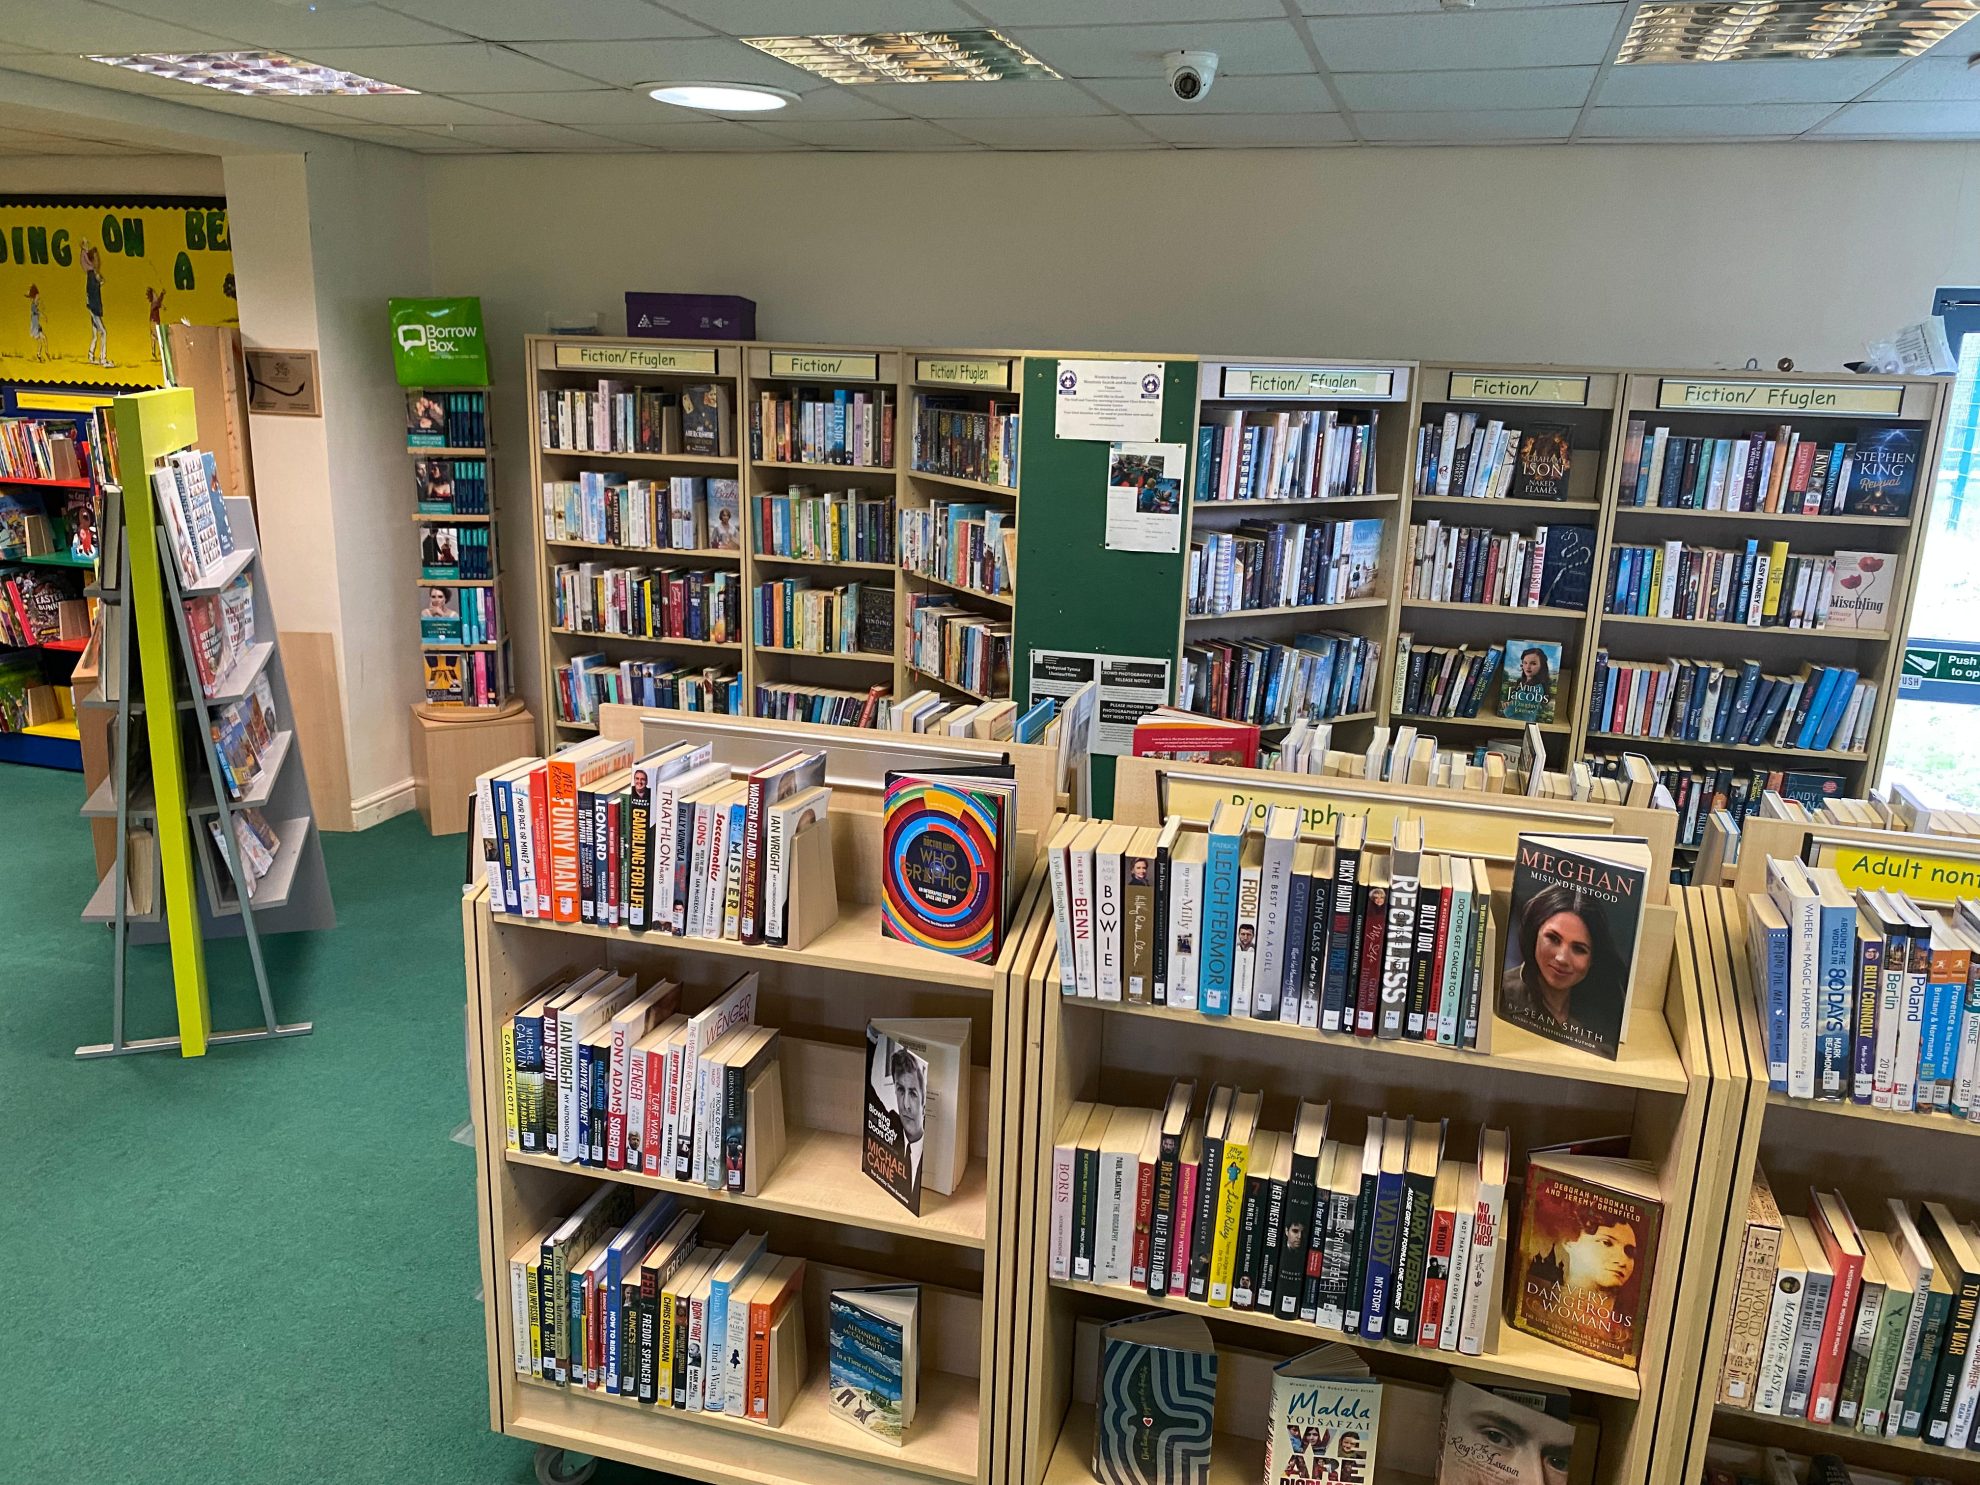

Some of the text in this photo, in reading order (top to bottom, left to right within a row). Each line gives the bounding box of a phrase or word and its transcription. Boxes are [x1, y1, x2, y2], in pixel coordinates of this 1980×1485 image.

[102, 214, 144, 257] ON
[186, 211, 231, 250] BE
[174, 252, 195, 290] A
[426, 325, 476, 338] Borrow
[428, 339, 458, 352] Box.
[581, 349, 675, 367] Fiction/ Ffuglen
[792, 358, 842, 373] Fiction/
[930, 364, 988, 386] Fiction/ Ffuglen
[1250, 374, 1357, 392] Fiction/ Ffuglen
[1473, 379, 1539, 395] Fiction/
[1685, 386, 1836, 408] Fiction/ Ffuglen
[1523, 463, 1564, 477] ISON
[1527, 455, 1563, 463] GRAHAM
[1854, 451, 1915, 463] STEPHEN
[1860, 462, 1904, 476] KING
[1525, 486, 1557, 494] FLAMES
[1754, 558, 1767, 604] EASY MONEY
[38, 602, 58, 611] BUNN
[1830, 596, 1883, 614] Mischling
[1948, 656, 1977, 665] Push
[1952, 668, 1980, 679] to op
[1508, 687, 1548, 703] Jacobs
[1517, 682, 1541, 692] Anna
[1902, 677, 1919, 686] USH
[1789, 791, 1817, 800] ANDY
[521, 831, 526, 839] OR
[596, 799, 606, 860] LEONARD
[632, 809, 646, 866] GAMBLING
[660, 790, 672, 866] TRIATHLON
[747, 783, 759, 860] WARREN GATLAND
[552, 798, 577, 891] FUNNY MAN
[710, 813, 725, 881] Soccermatics
[920, 848, 956, 869] WHO
[632, 867, 645, 887] FOR
[727, 841, 742, 908] MISTER
[1520, 848, 1635, 896] MEGHAN
[1852, 855, 1922, 879] Adult
[1241, 879, 1258, 918] FROCH
[1336, 859, 1355, 913] RICKY HATTON
[1531, 871, 1618, 903] MISUNDERSTOOD
[1075, 899, 1089, 939] BENN
[1100, 885, 1117, 967] BOWIE
[1208, 851, 1232, 985] LEIGH FERMOR
[1311, 889, 1324, 951] CATHY GLASS
[1417, 904, 1436, 953] BILLY IDOL
[1457, 899, 1465, 932] DOCTORS
[1382, 875, 1419, 1003] RECKLESS
[1451, 950, 1460, 980] CANCER
[1448, 982, 1456, 997] TOO
[1884, 973, 1901, 1009] Berlin
[1907, 977, 1925, 1022] Poland
[1524, 1008, 1555, 1026] SEAN
[1562, 1022, 1603, 1042] SMITH
[1826, 992, 1843, 1031] DAYS
[1967, 1016, 1979, 1044] VENICE
[544, 1016, 556, 1080] ALAN SMITH
[560, 1020, 572, 1092] IAN WRIGHT
[609, 1030, 625, 1113] TONY ADAMS
[868, 1103, 891, 1128] Blowing
[878, 1119, 898, 1141] Bloody
[868, 1119, 894, 1146] Doors Off
[868, 1138, 907, 1180] MICHAEL
[868, 1153, 894, 1183] CAINE
[1059, 1164, 1069, 1203] BORIS
[1114, 1172, 1122, 1201] McCARTNEY
[1159, 1161, 1173, 1233] BREAK POINT OLLIE
[1554, 1182, 1635, 1212] DEBORAH McDONALD
[1219, 1189, 1239, 1240] Lisa Riley
[1267, 1184, 1282, 1248] HER FINEST HOUR
[1477, 1213, 1497, 1225] WALL
[1478, 1202, 1489, 1213] NO
[1546, 1188, 1641, 1222] AND JEREMY DRONFIELD
[1330, 1196, 1349, 1288] BRUCE SPRINGSTEEN
[1372, 1200, 1399, 1266] VARDY
[1474, 1235, 1493, 1247] HIGH
[1477, 1224, 1492, 1235] TOO
[1405, 1191, 1430, 1313] MARK WEBBER
[543, 1254, 554, 1325] THE WILD BOOK
[1371, 1277, 1384, 1313] MY STORY
[1527, 1282, 1632, 1327] DANGEROUS
[1552, 1280, 1608, 1305] A VERY
[661, 1296, 671, 1362] CHRIS BOARDMAN
[1542, 1300, 1611, 1333] WOMAN
[1735, 1282, 1757, 1345] HISTORY
[1747, 1289, 1767, 1337] WORLD
[1950, 1285, 1979, 1356] TO WIN A WAR
[641, 1313, 652, 1384] FREDDIE SPENCER
[843, 1328, 886, 1352] McCALL SMITH
[848, 1324, 881, 1344] ALEXANDER
[848, 1358, 860, 1368] Time
[868, 1367, 892, 1383] Distance
[1288, 1389, 1371, 1419] Malala
[1286, 1415, 1371, 1430] YOUSAFZAI
[1287, 1425, 1369, 1458] WE
[1283, 1454, 1365, 1482] ARE
